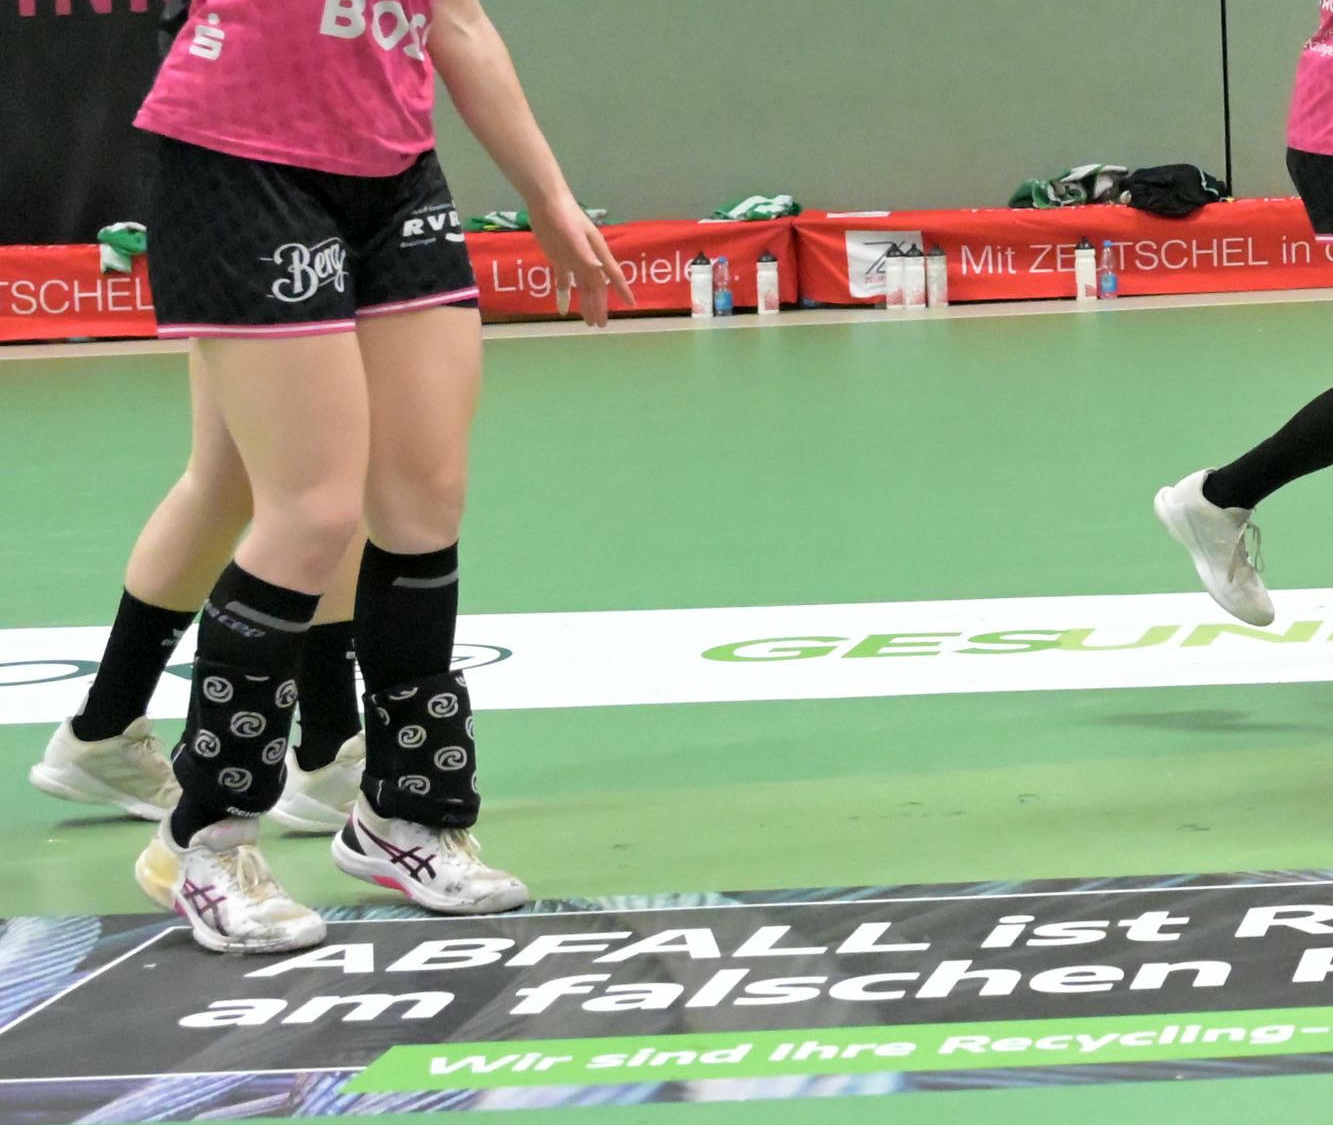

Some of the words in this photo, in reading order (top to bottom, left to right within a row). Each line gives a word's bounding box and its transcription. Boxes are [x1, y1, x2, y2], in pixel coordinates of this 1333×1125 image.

[961, 244, 1016, 276] Mit
[1028, 237, 1269, 277] ZETSCHEL
[1282, 235, 1311, 265] in
[244, 921, 931, 978] ABFALL
[981, 911, 1189, 948] ist
[179, 992, 454, 1027] am
[509, 958, 1232, 1017] falschen
[429, 1051, 555, 1075] Wir
[567, 1041, 750, 1071] sind
[767, 1037, 917, 1063] Ihre
